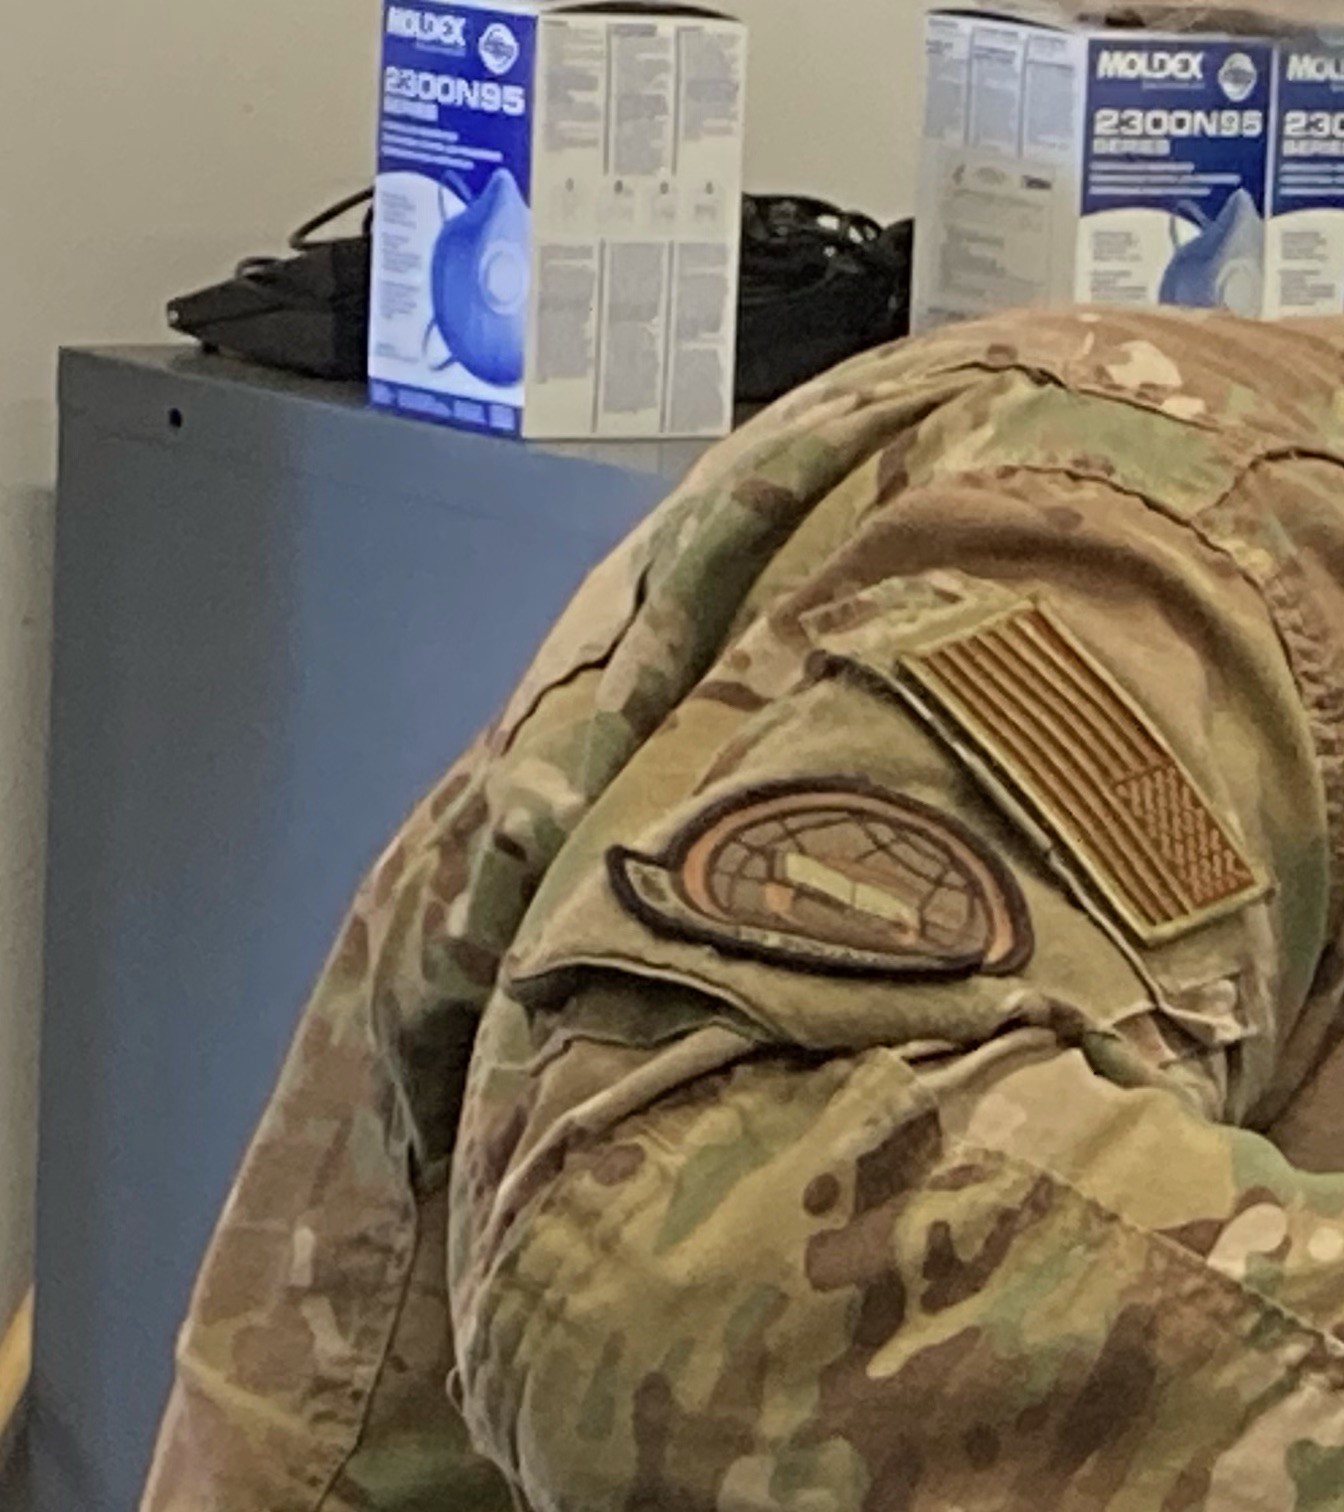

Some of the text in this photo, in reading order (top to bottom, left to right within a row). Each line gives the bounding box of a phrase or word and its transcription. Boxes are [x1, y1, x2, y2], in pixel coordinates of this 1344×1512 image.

[1097, 50, 1203, 80] MOLDEX
[384, 66, 526, 117] 2300N95
[1093, 109, 1263, 138] 2300N95
